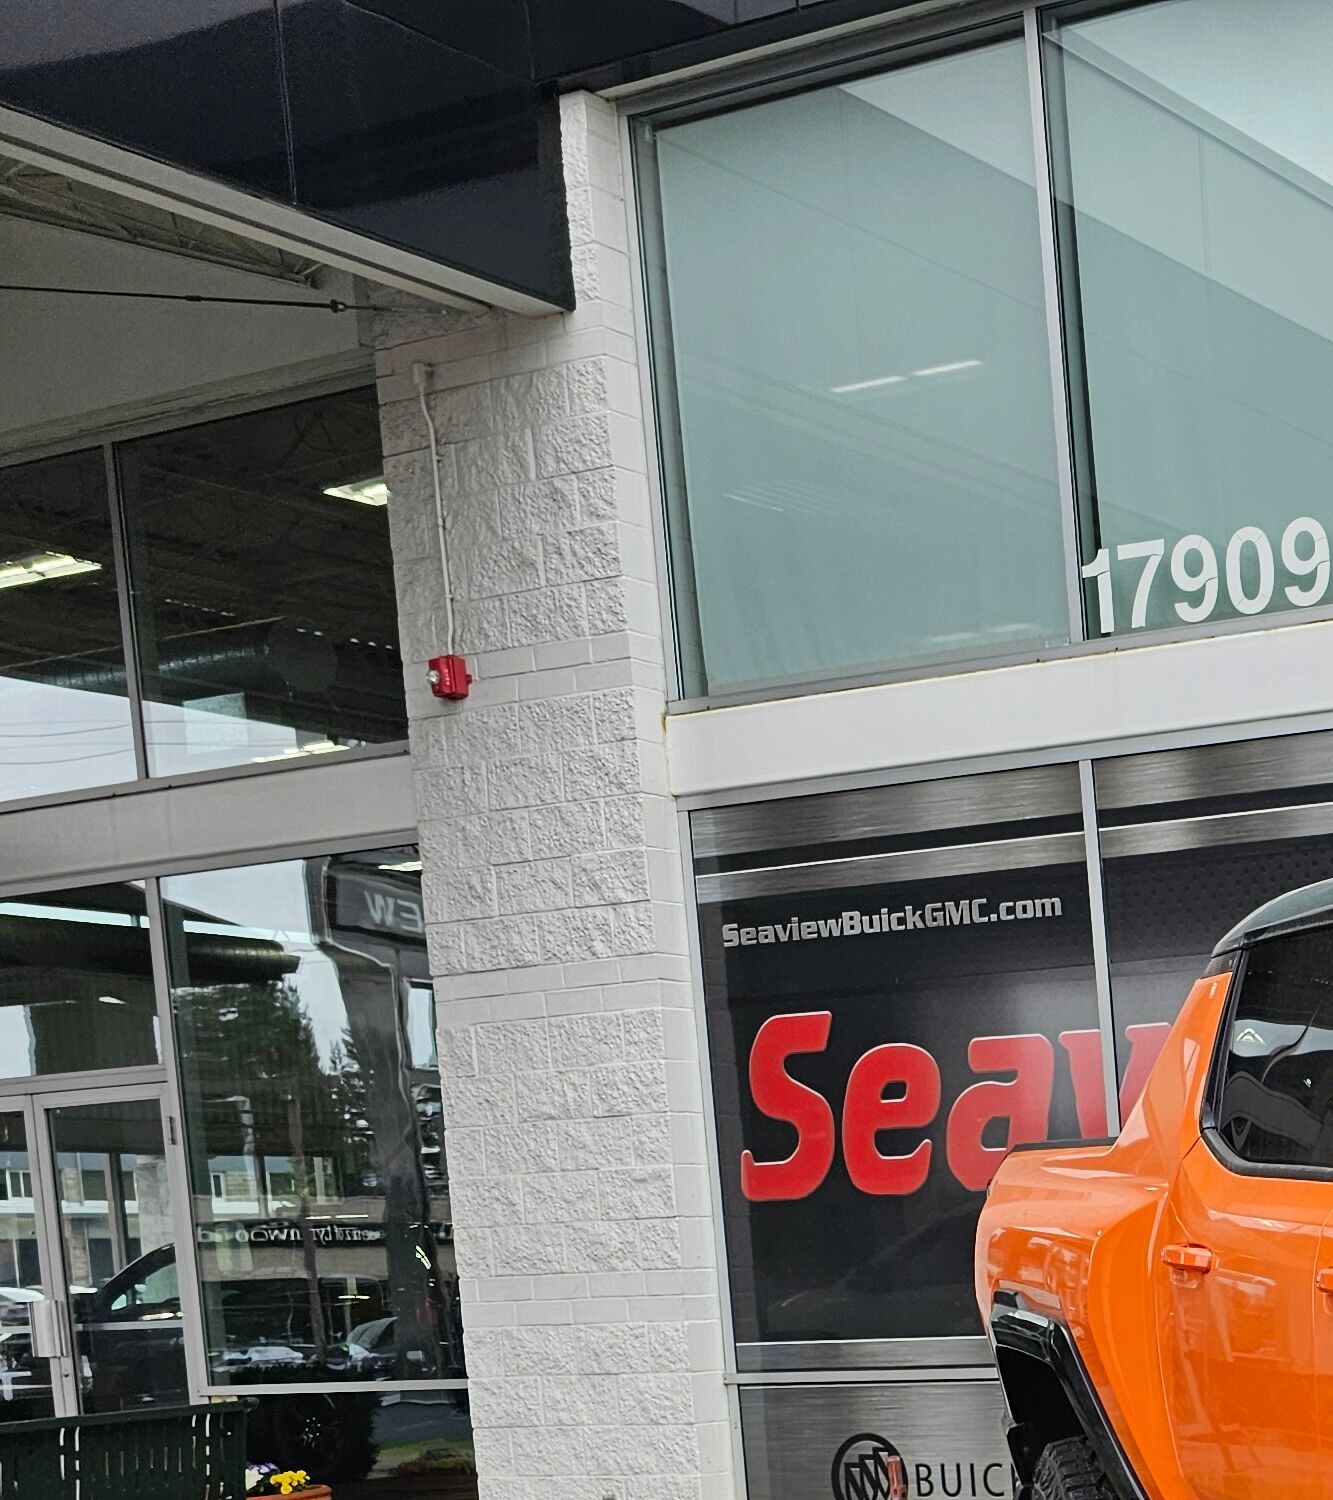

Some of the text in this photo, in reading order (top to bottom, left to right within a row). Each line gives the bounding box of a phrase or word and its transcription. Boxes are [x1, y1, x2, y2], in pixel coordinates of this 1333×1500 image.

[1081, 516, 1331, 634] 17909
[722, 896, 1063, 948] SeaviewBuickGMC.com
[915, 1462, 1016, 1498] BUIC
